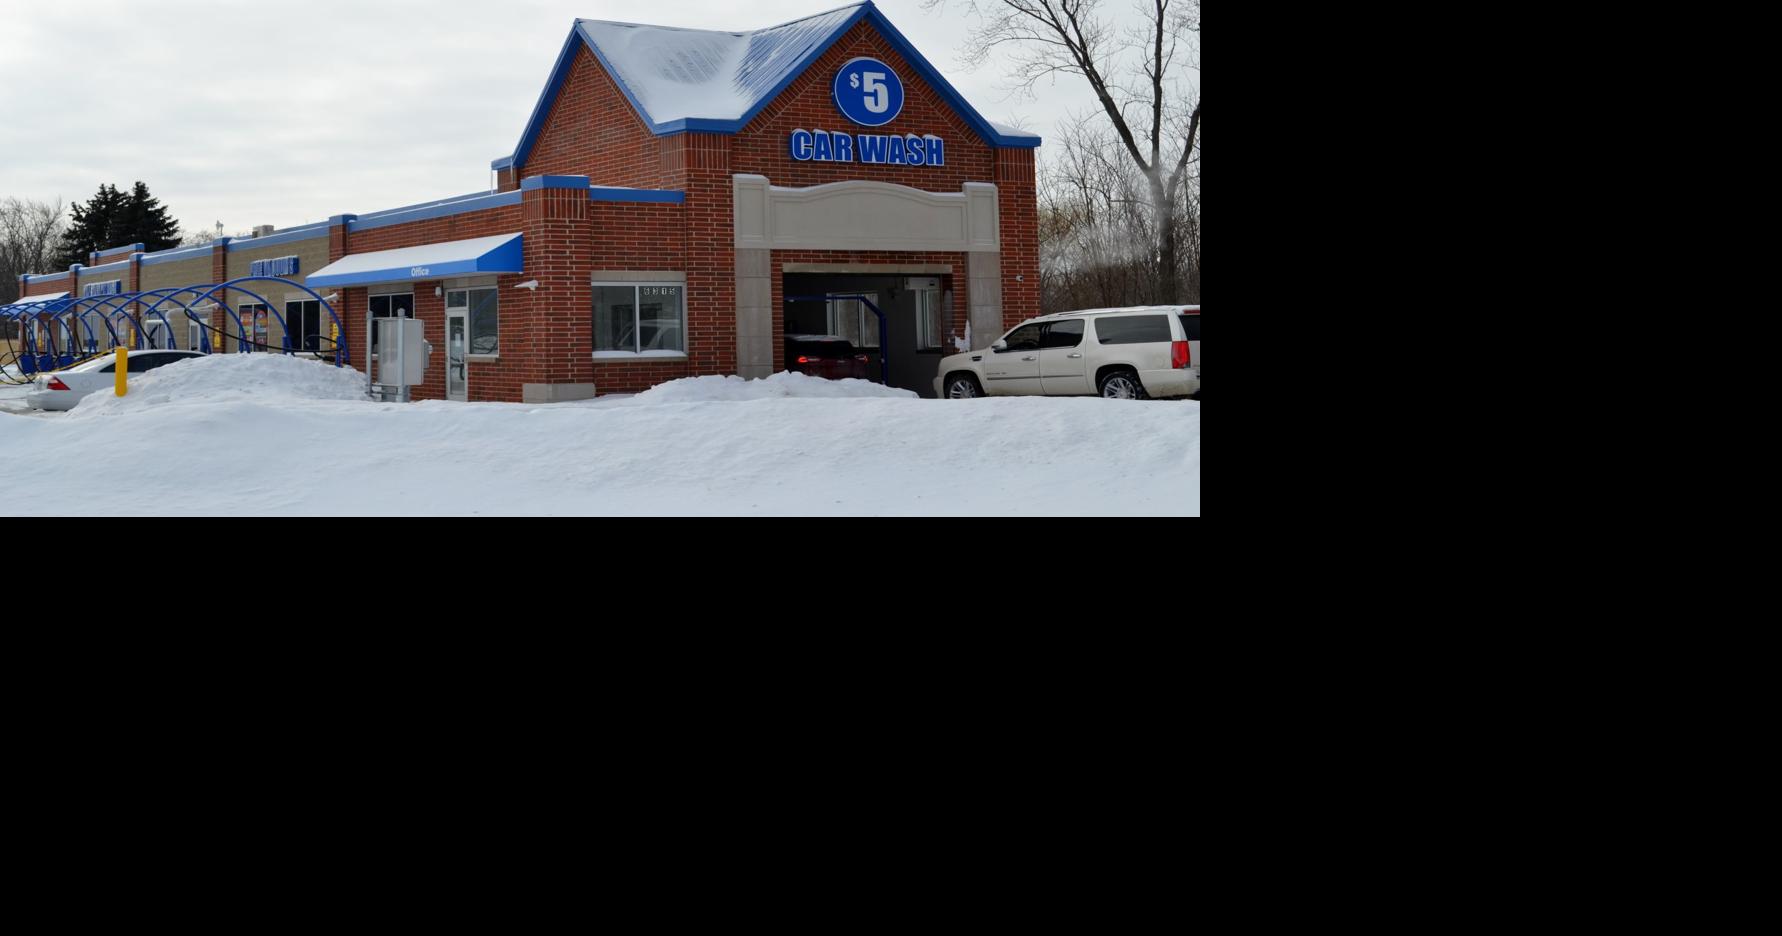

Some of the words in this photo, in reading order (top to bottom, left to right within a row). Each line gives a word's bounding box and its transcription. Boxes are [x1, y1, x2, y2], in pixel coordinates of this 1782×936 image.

[850, 72, 889, 113] $5
[791, 130, 853, 162] CAR
[857, 134, 944, 166] WASH
[411, 266, 429, 277] Office
